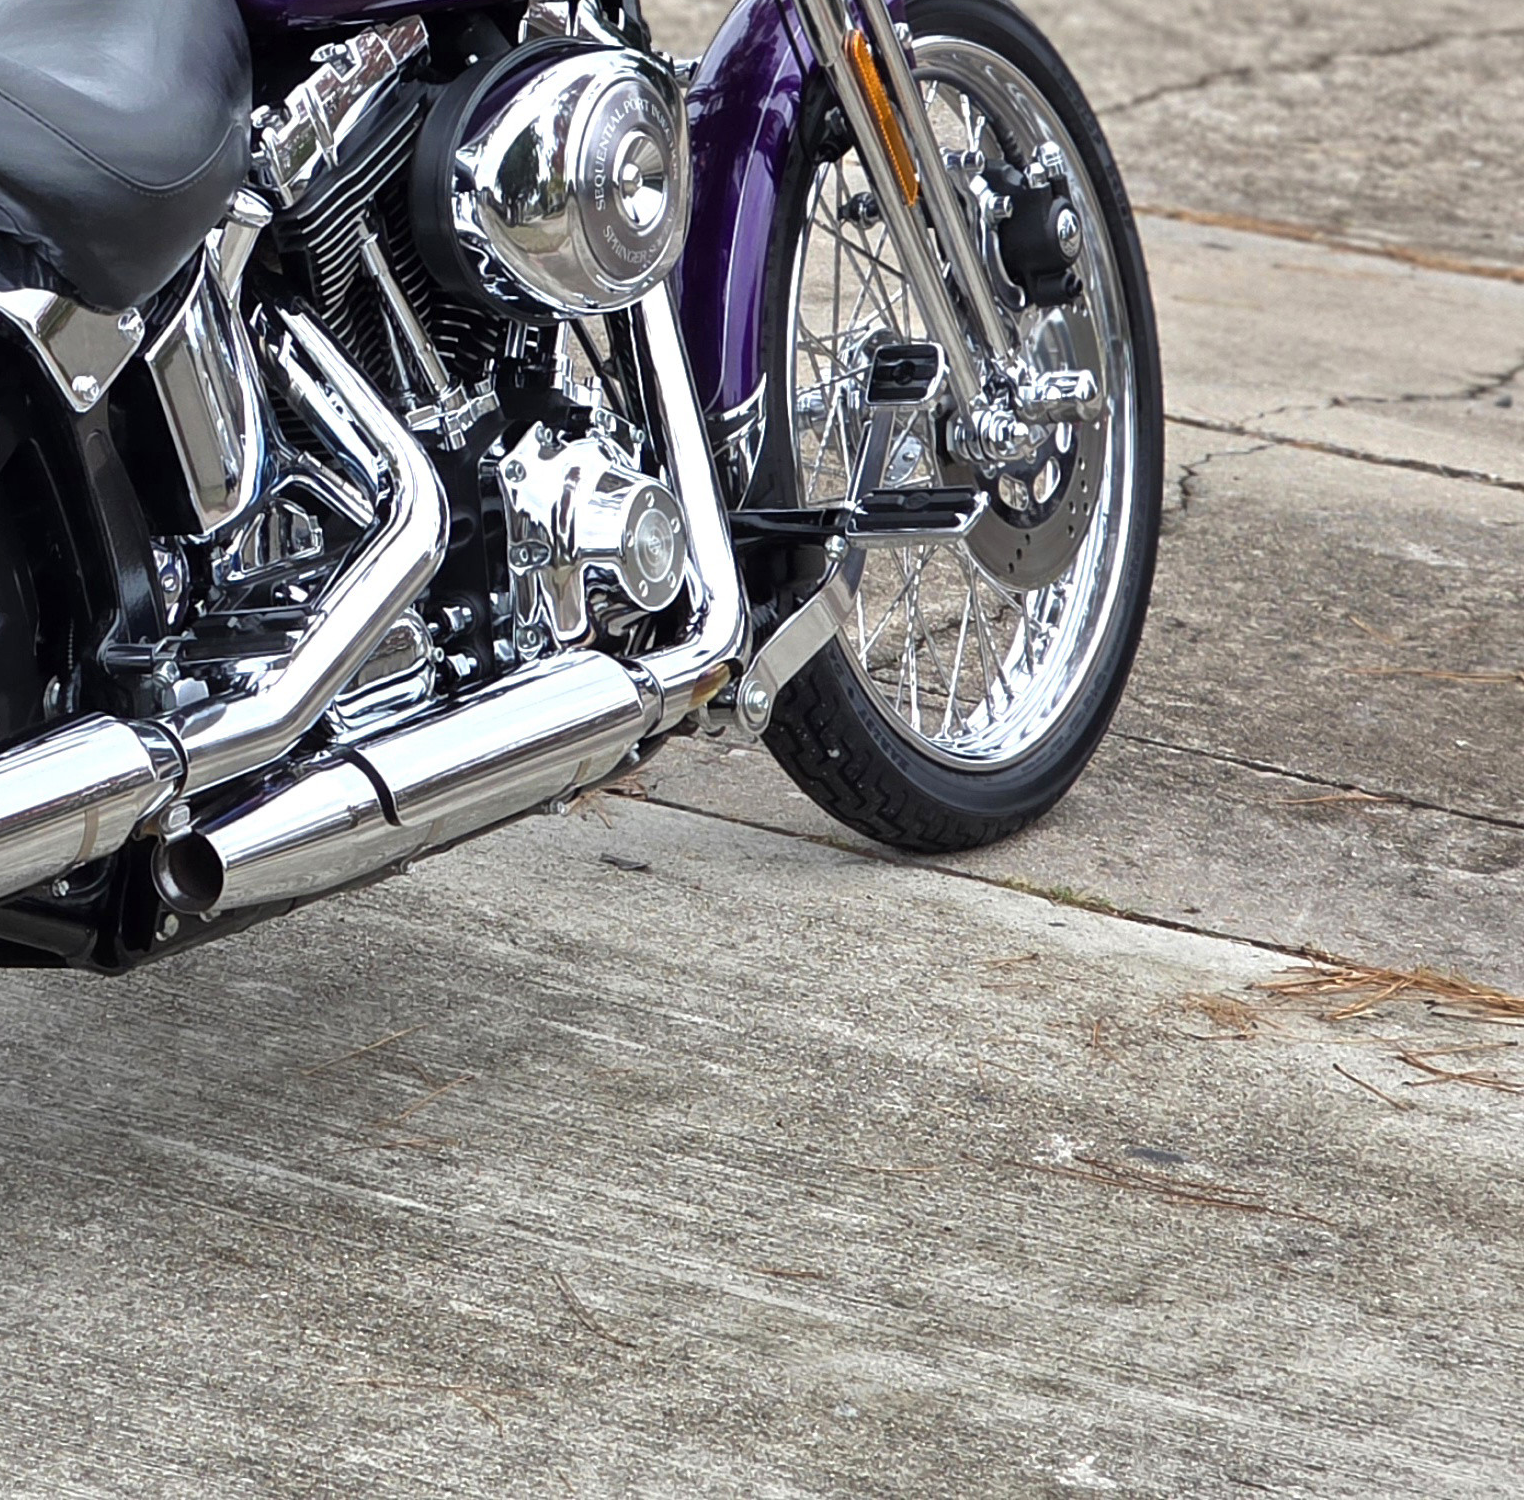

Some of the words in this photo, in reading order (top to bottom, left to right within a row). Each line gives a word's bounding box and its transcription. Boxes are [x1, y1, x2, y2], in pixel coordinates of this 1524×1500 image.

[594, 108, 625, 211] SEQUENTIAL
[623, 98, 649, 115] PORT
[603, 225, 648, 264] SPRINGER
